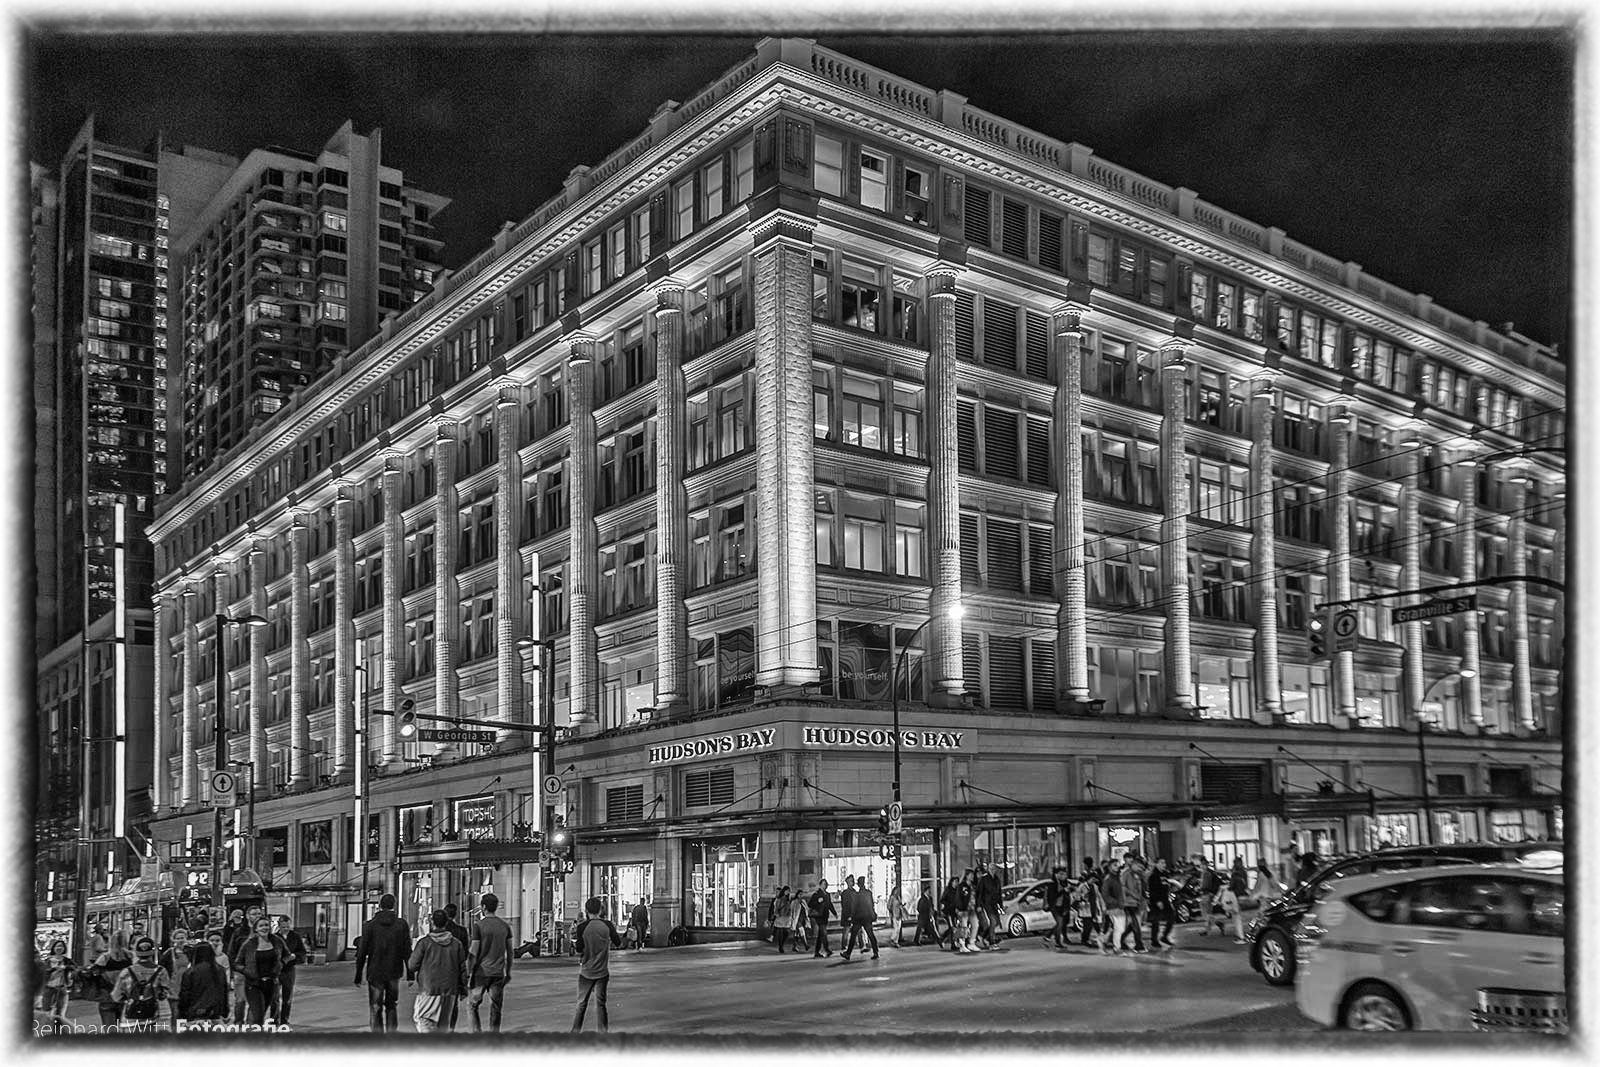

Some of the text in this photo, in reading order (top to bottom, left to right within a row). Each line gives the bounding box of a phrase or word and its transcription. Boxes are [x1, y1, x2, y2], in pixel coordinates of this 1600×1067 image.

[1398, 603, 1454, 620] Granville
[424, 731, 491, 742] W Georgia St
[803, 727, 964, 748] HUDSON'S BAY
[649, 728, 776, 763] HUDSON'S BAY
[463, 805, 495, 822] TOPSHO
